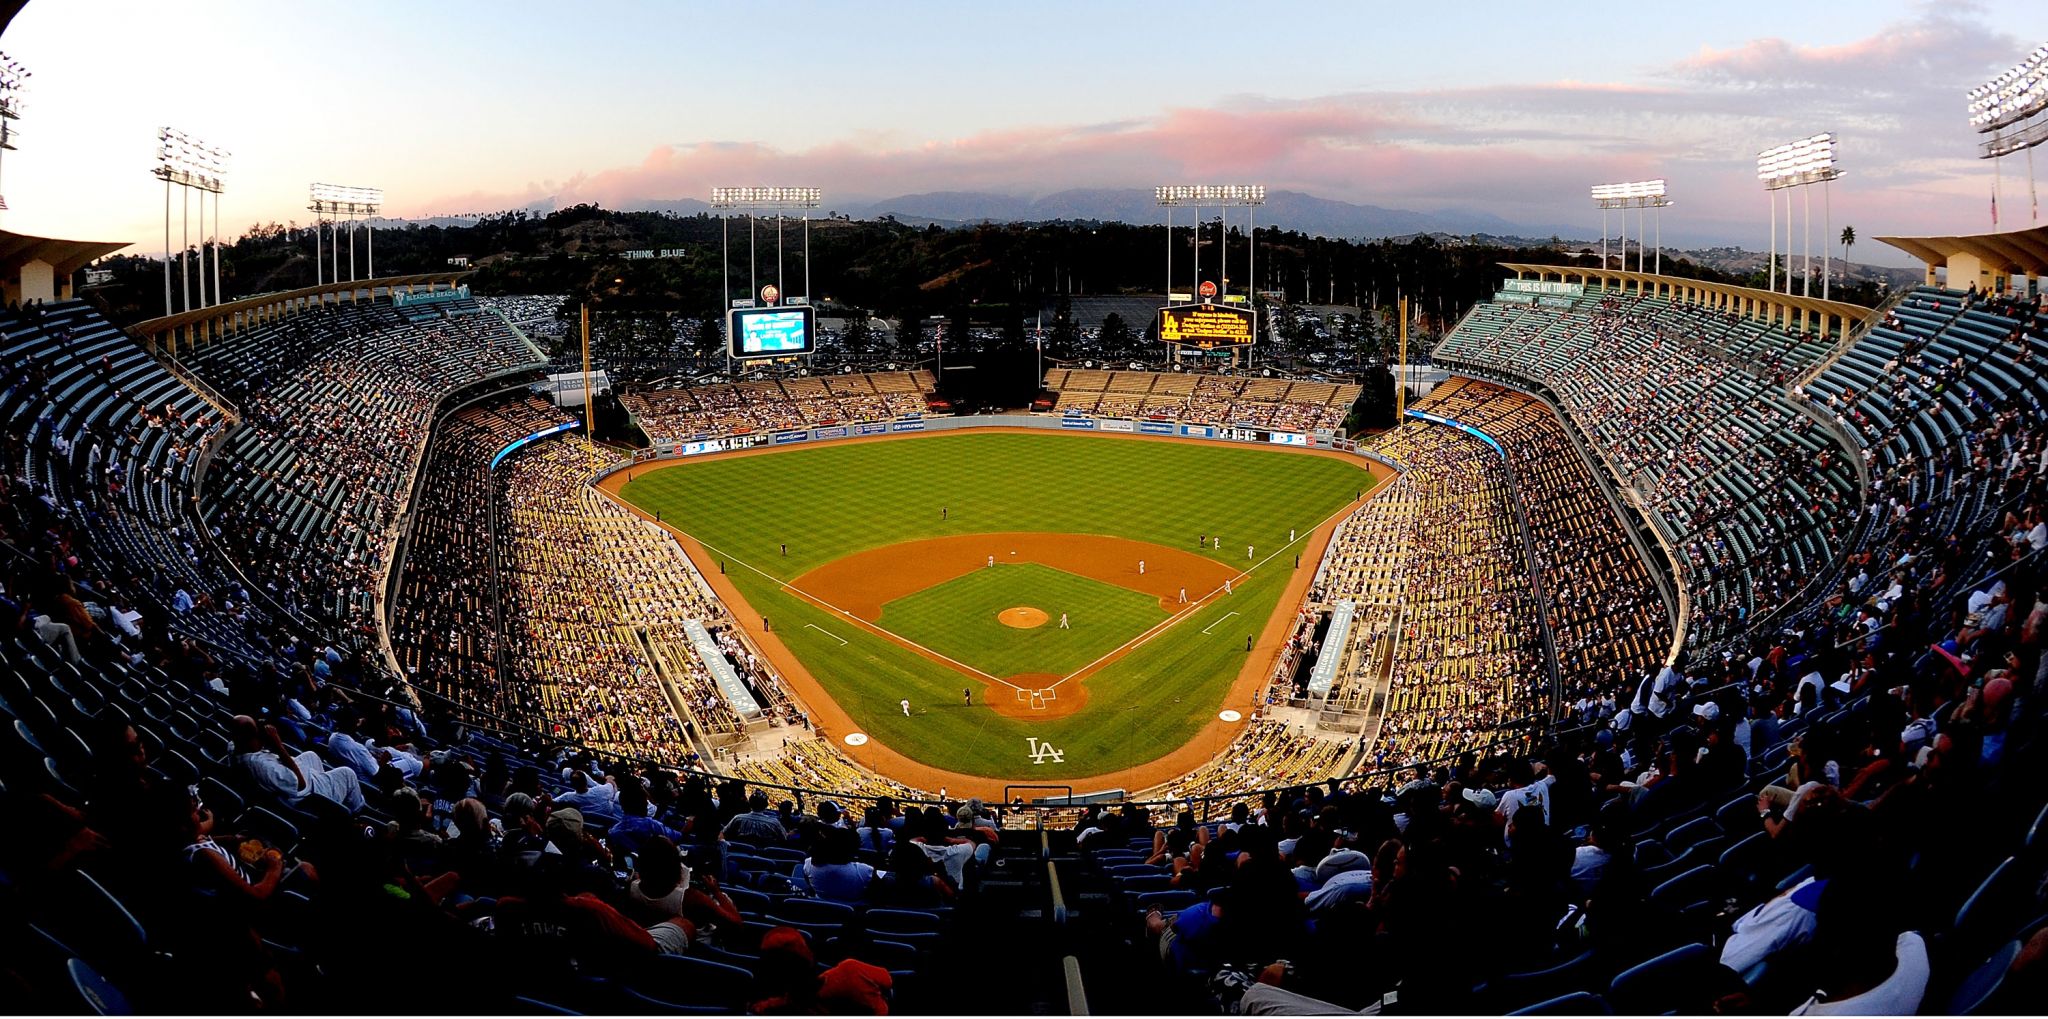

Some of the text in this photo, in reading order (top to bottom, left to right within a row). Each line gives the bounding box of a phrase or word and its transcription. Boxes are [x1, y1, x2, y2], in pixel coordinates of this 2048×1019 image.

[626, 248, 686, 259] THINK BLUE
[1517, 282, 1572, 293] THIS IS MY TOWN
[406, 290, 456, 301] BLEACHER BEACH
[1163, 310, 1179, 333] LA
[901, 422, 924, 430] HYUNDAI
[711, 656, 742, 696] WELCOME YOU
[1026, 737, 1064, 764] LA
